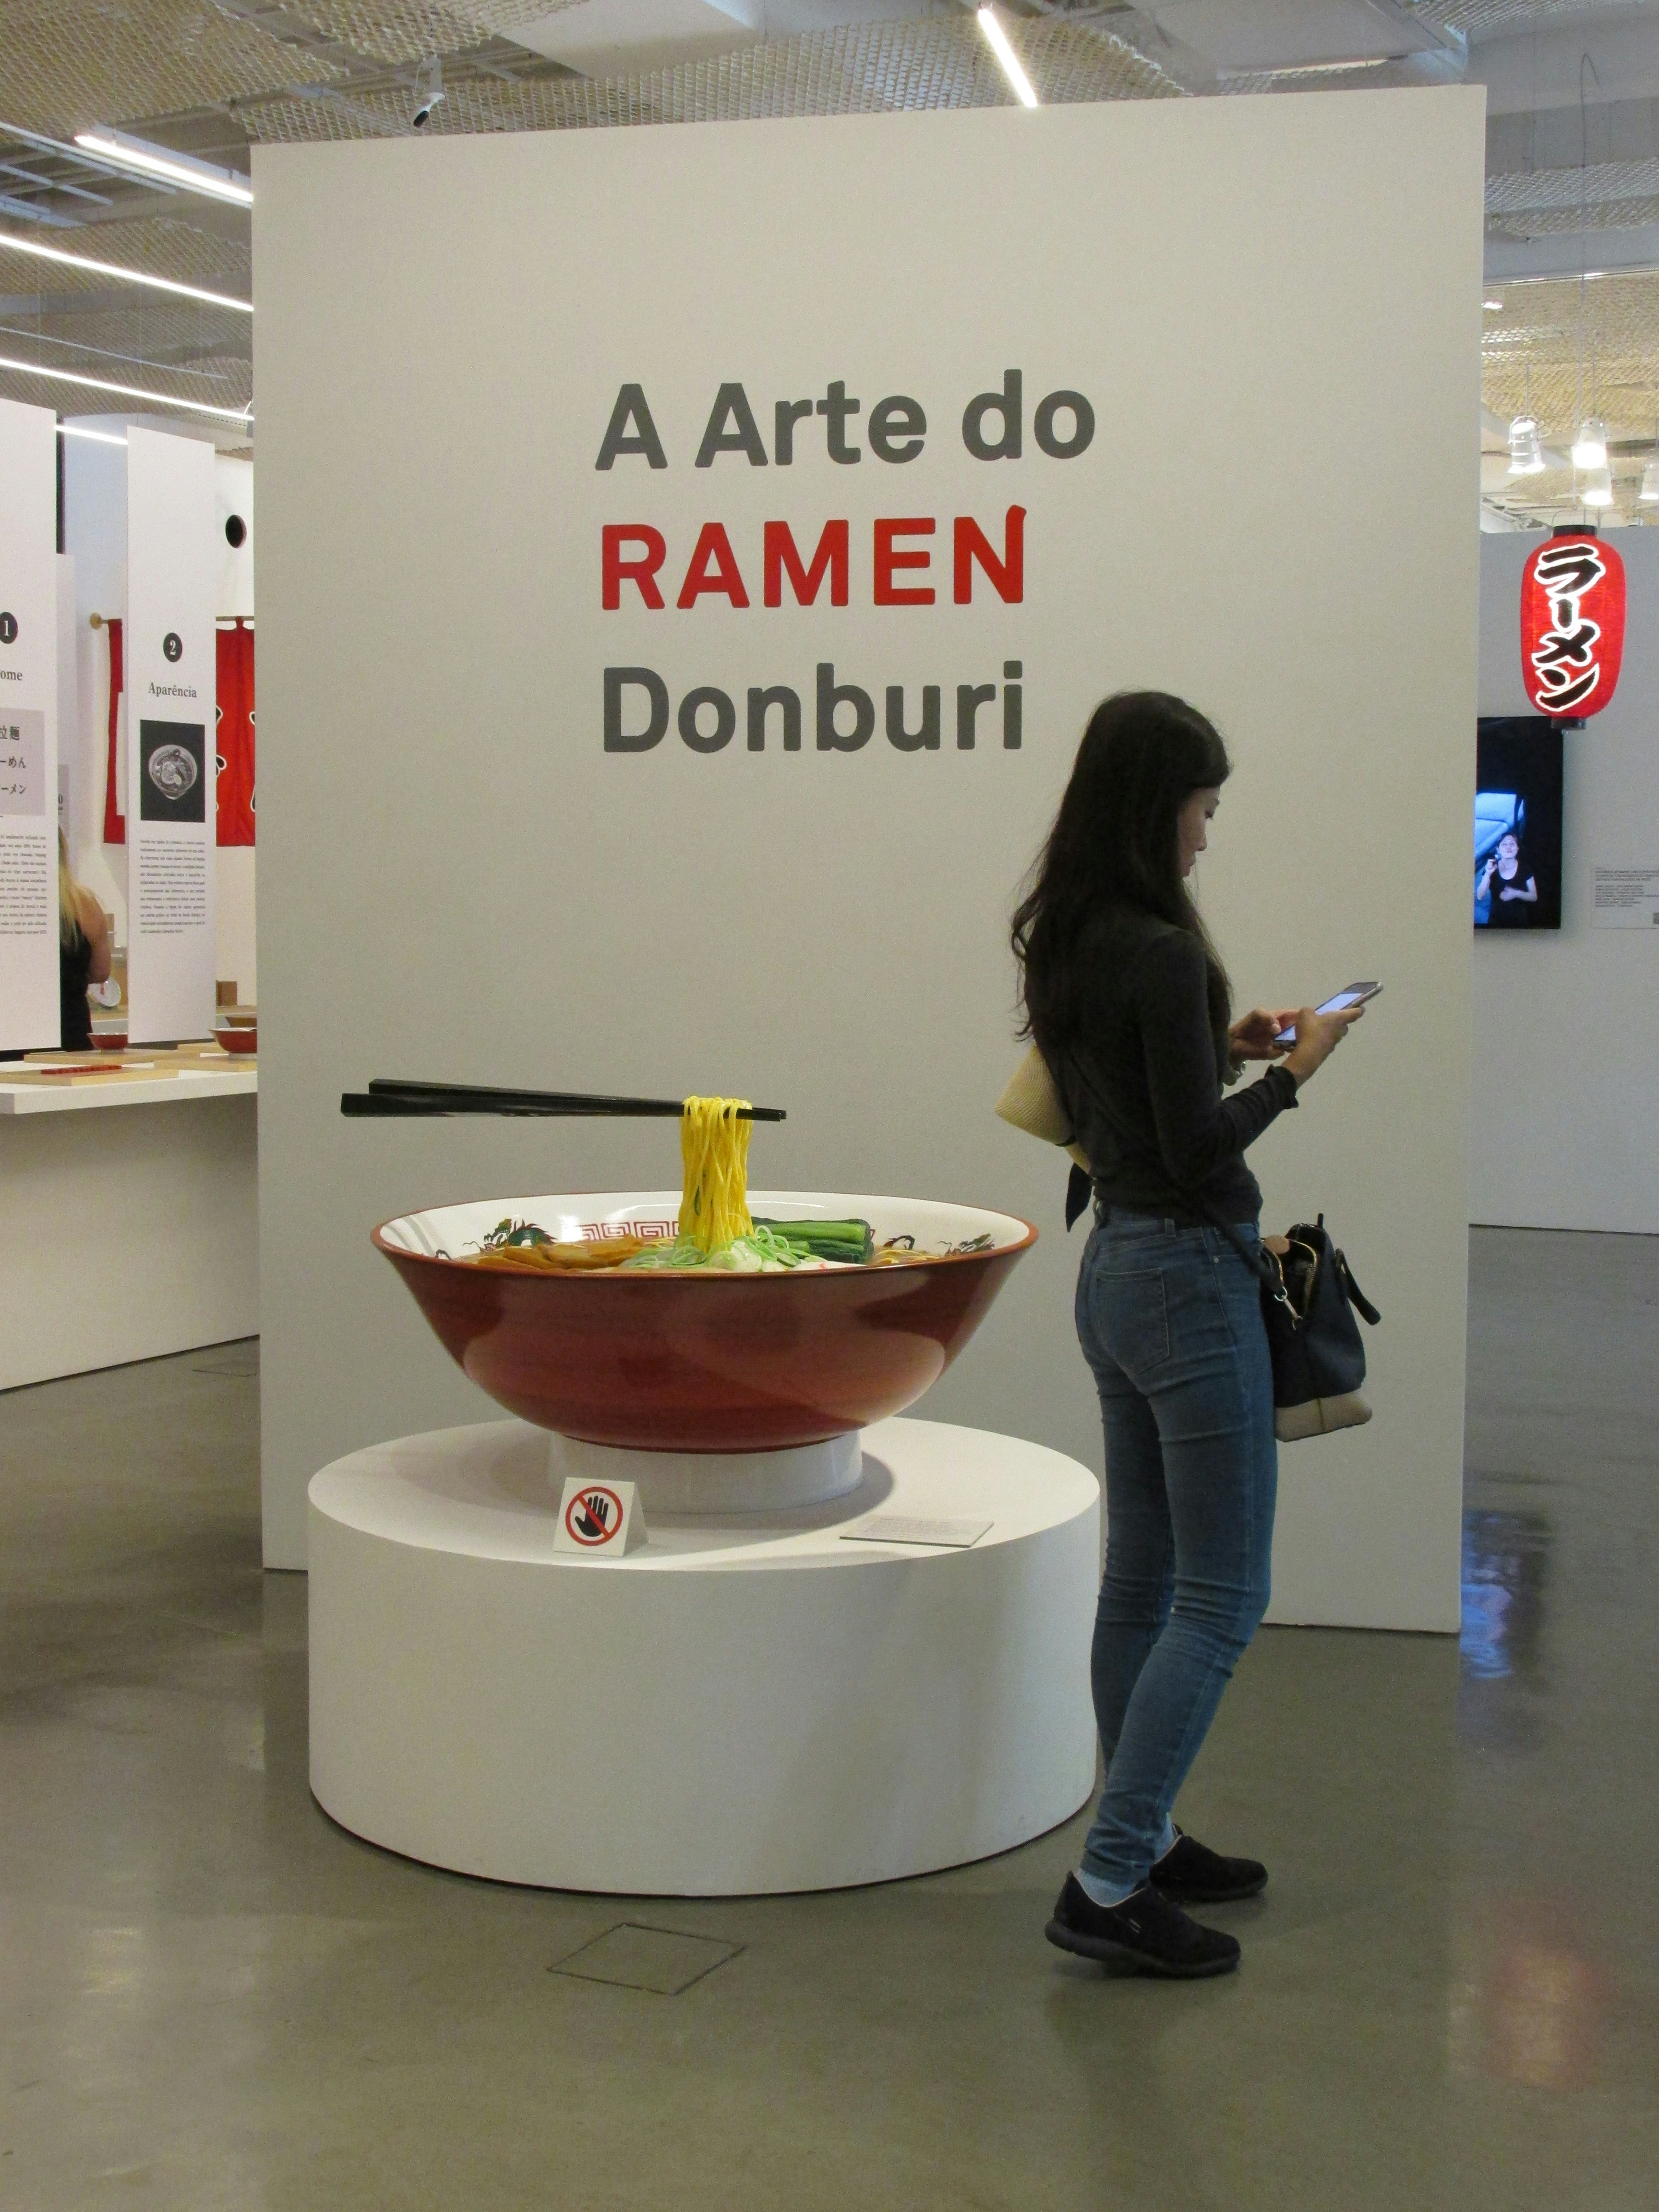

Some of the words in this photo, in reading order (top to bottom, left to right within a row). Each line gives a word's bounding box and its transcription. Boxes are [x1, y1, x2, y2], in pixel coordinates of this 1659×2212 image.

[596, 384, 667, 470] A
[695, 381, 926, 468] Arte
[962, 370, 1094, 461] do
[602, 505, 1026, 611] RAMEN
[4, 620, 10, 637] 1
[1532, 543, 1606, 711] ラーメン
[169, 640, 176, 655] 2
[0, 671, 23, 681] ome
[148, 682, 197, 698] Aparência
[604, 661, 1022, 753] Donburi
[0, 756, 26, 768] ーめん
[1, 784, 26, 794] ーメン
